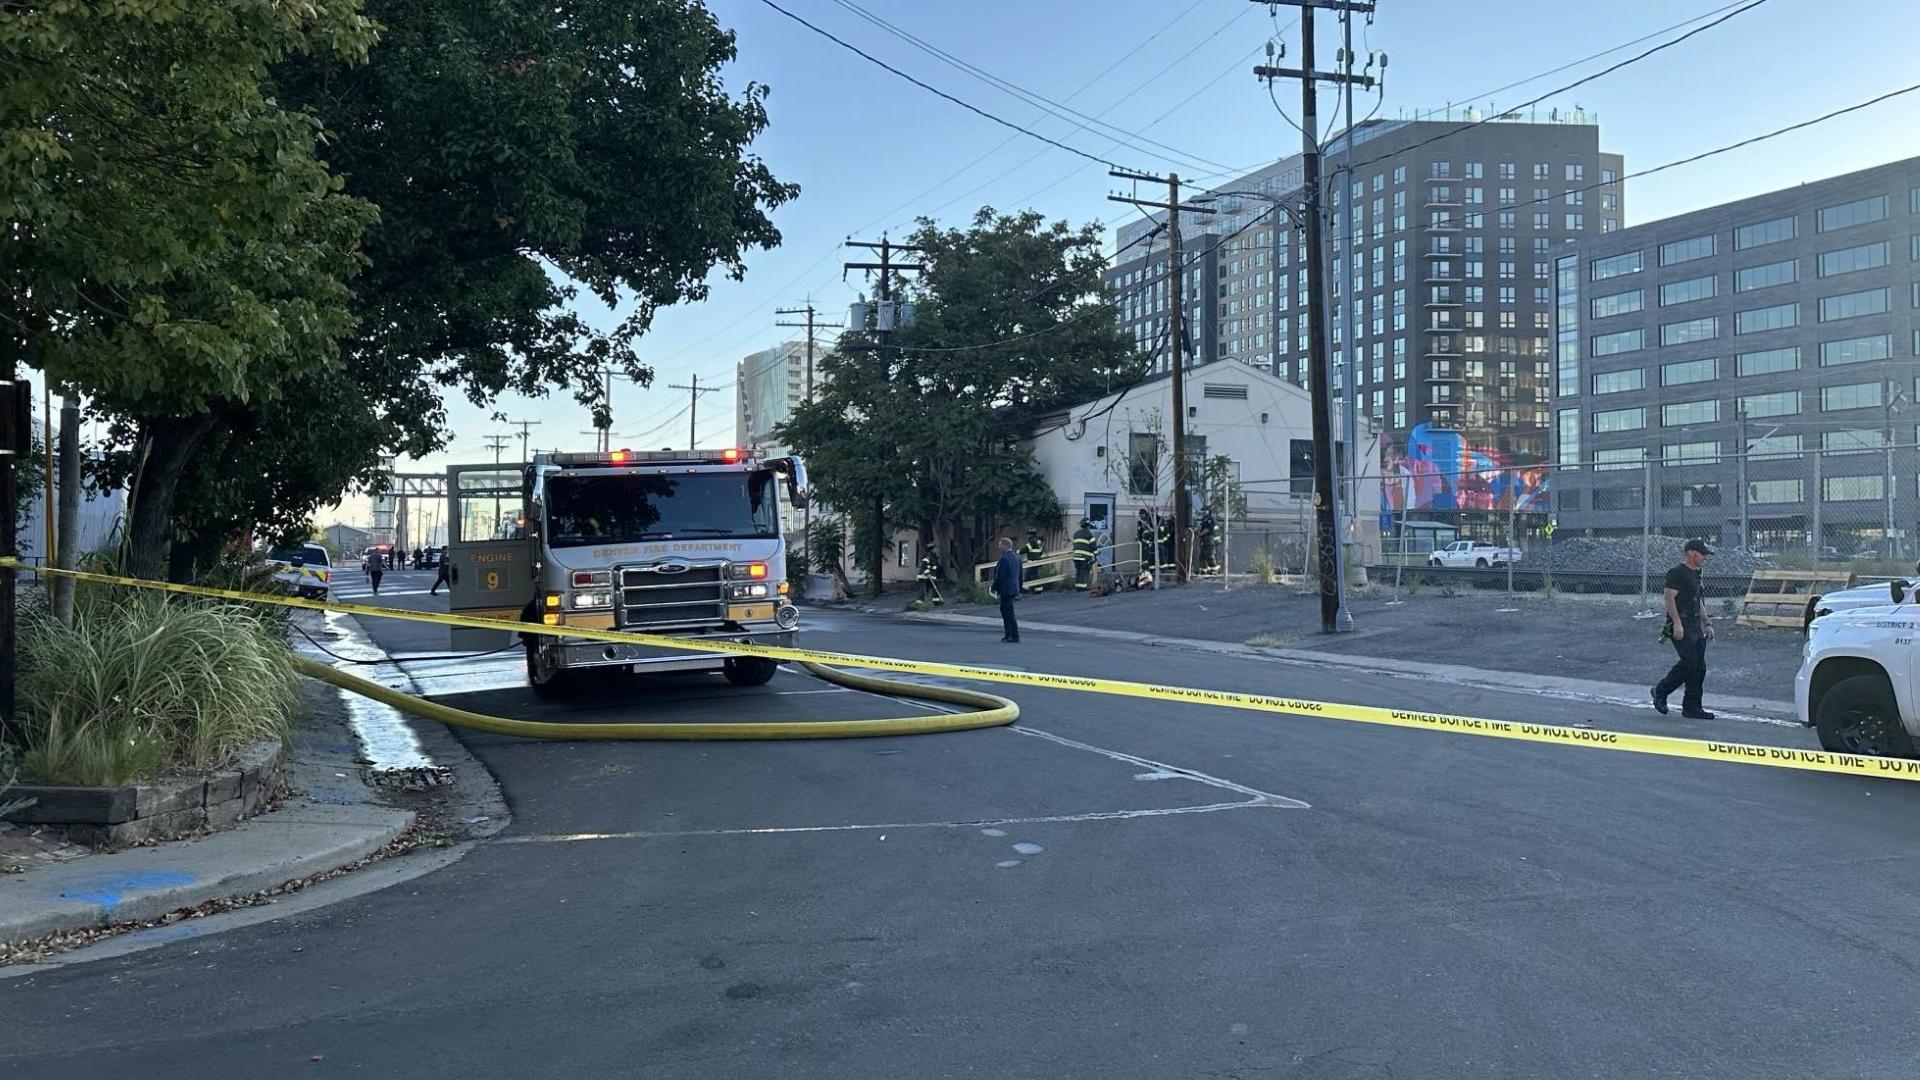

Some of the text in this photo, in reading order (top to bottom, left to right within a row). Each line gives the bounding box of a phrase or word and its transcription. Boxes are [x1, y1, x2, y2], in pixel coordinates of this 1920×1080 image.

[643, 544, 668, 554] FIRE
[673, 543, 743, 553] DEPARTMENT
[470, 553, 513, 564] ENGINE
[487, 572, 499, 589] 9
[1876, 621, 1907, 629] DISTRICT
